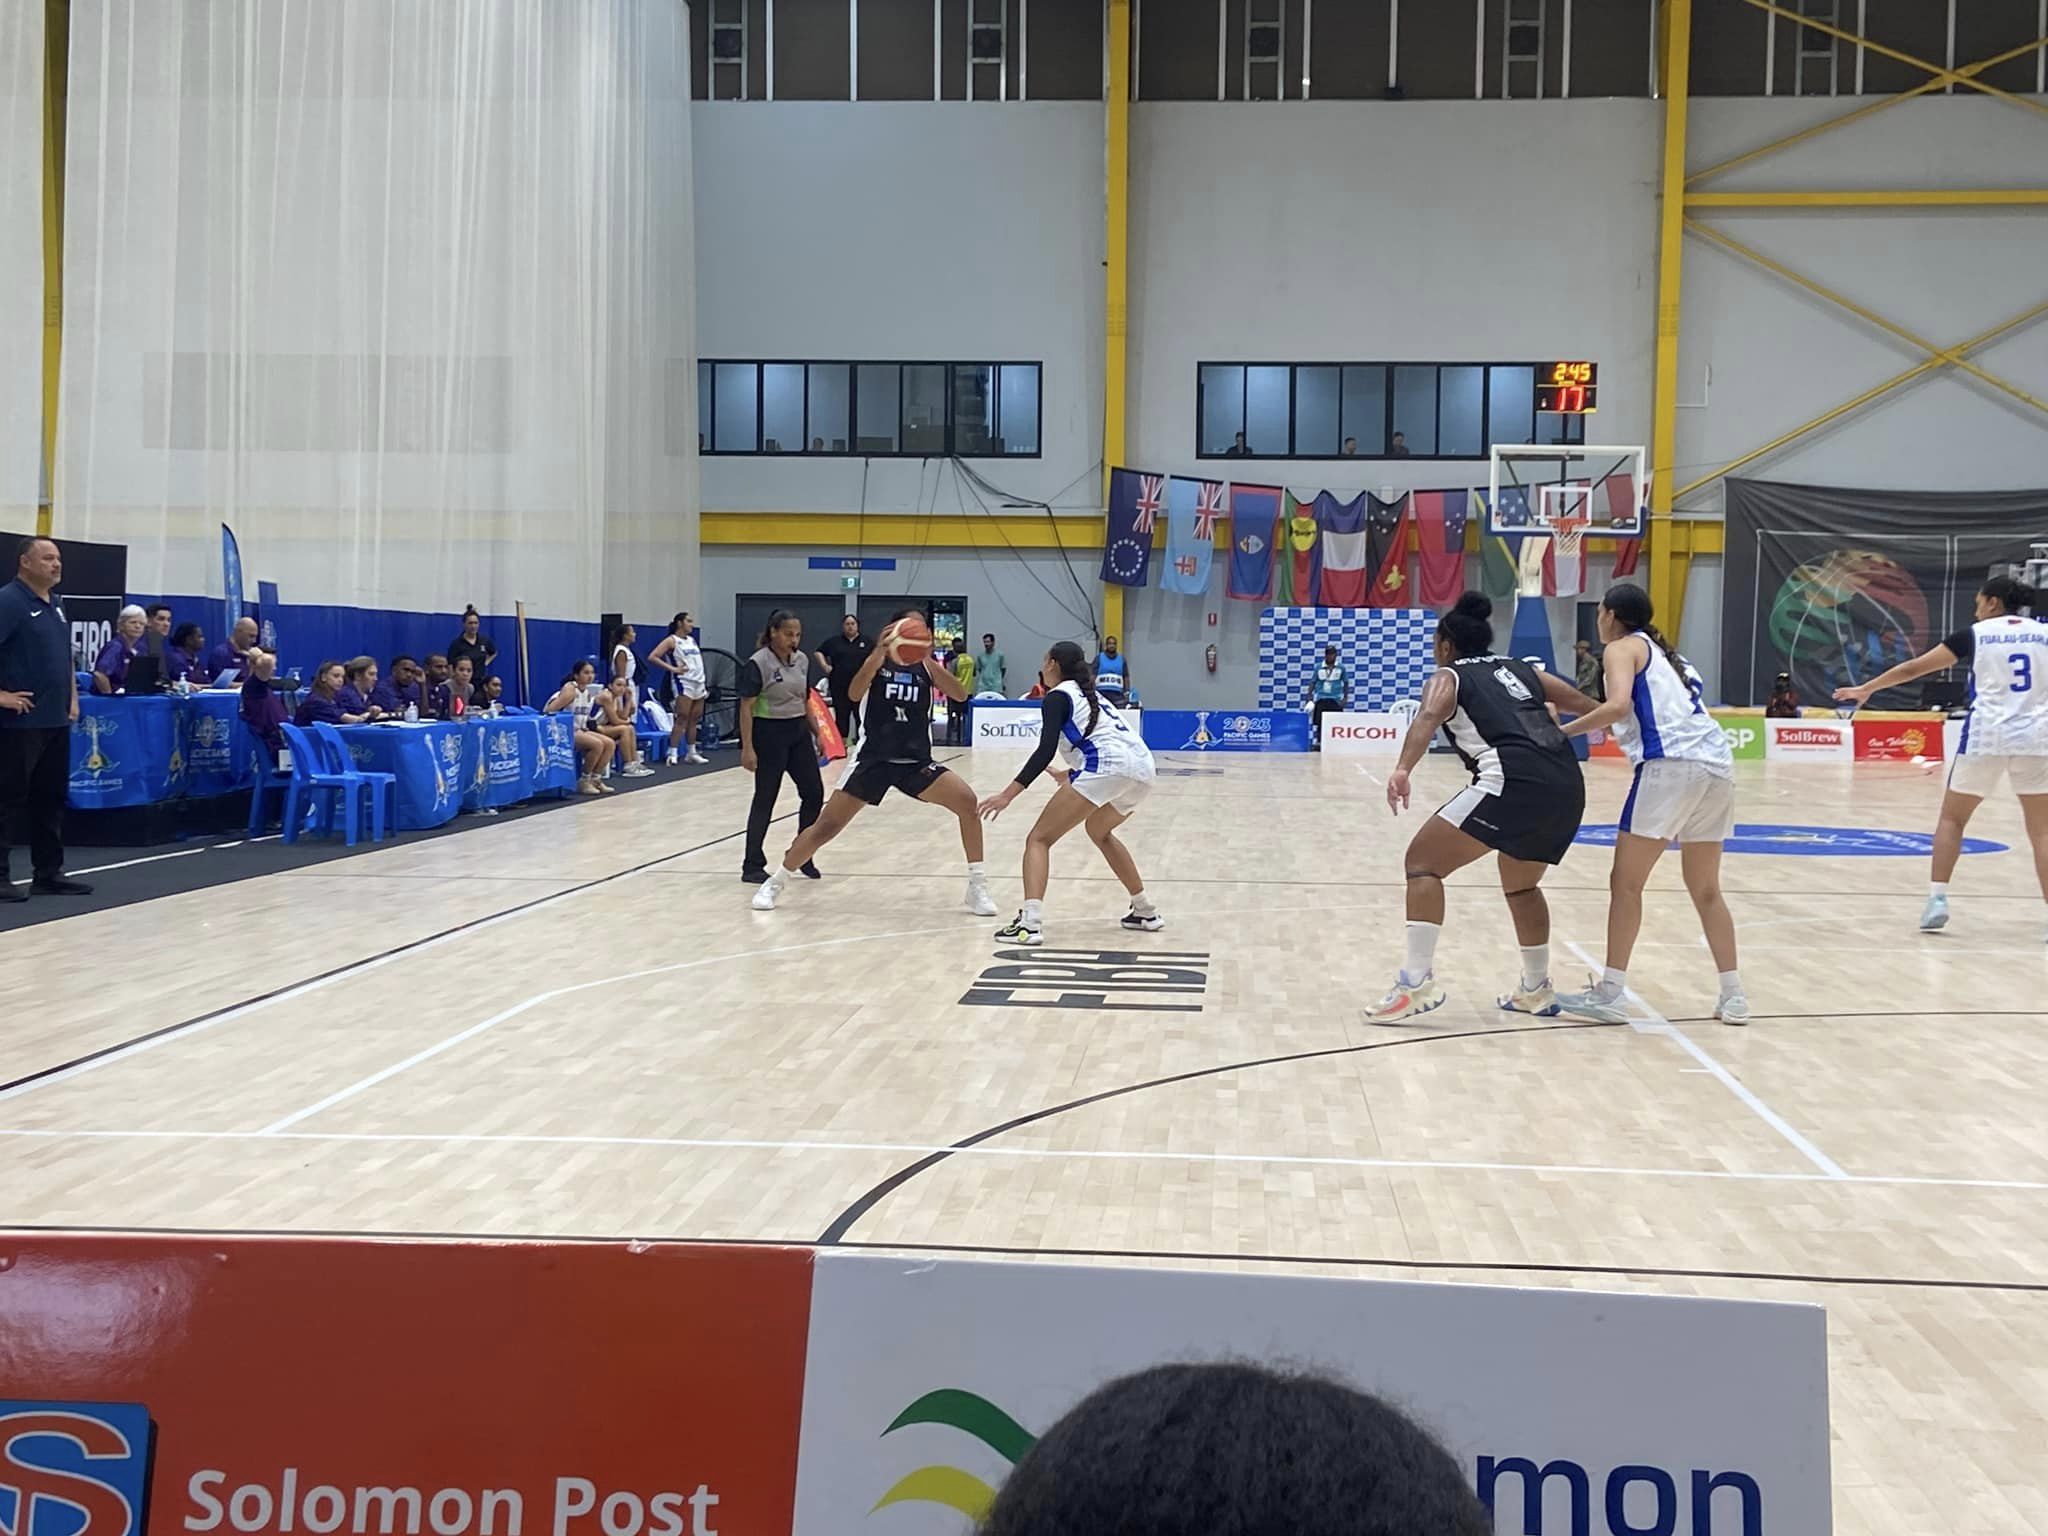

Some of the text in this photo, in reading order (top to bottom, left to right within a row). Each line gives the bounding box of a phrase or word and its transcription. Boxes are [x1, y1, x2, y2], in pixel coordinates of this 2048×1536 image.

[1558, 387, 1584, 411] 17
[2008, 653, 2032, 692] 3
[885, 683, 919, 702] FIJI
[1331, 726, 1397, 740] RICOH
[958, 949, 1210, 1012] FIBA
[184, 1468, 719, 1536] Solomon Post
